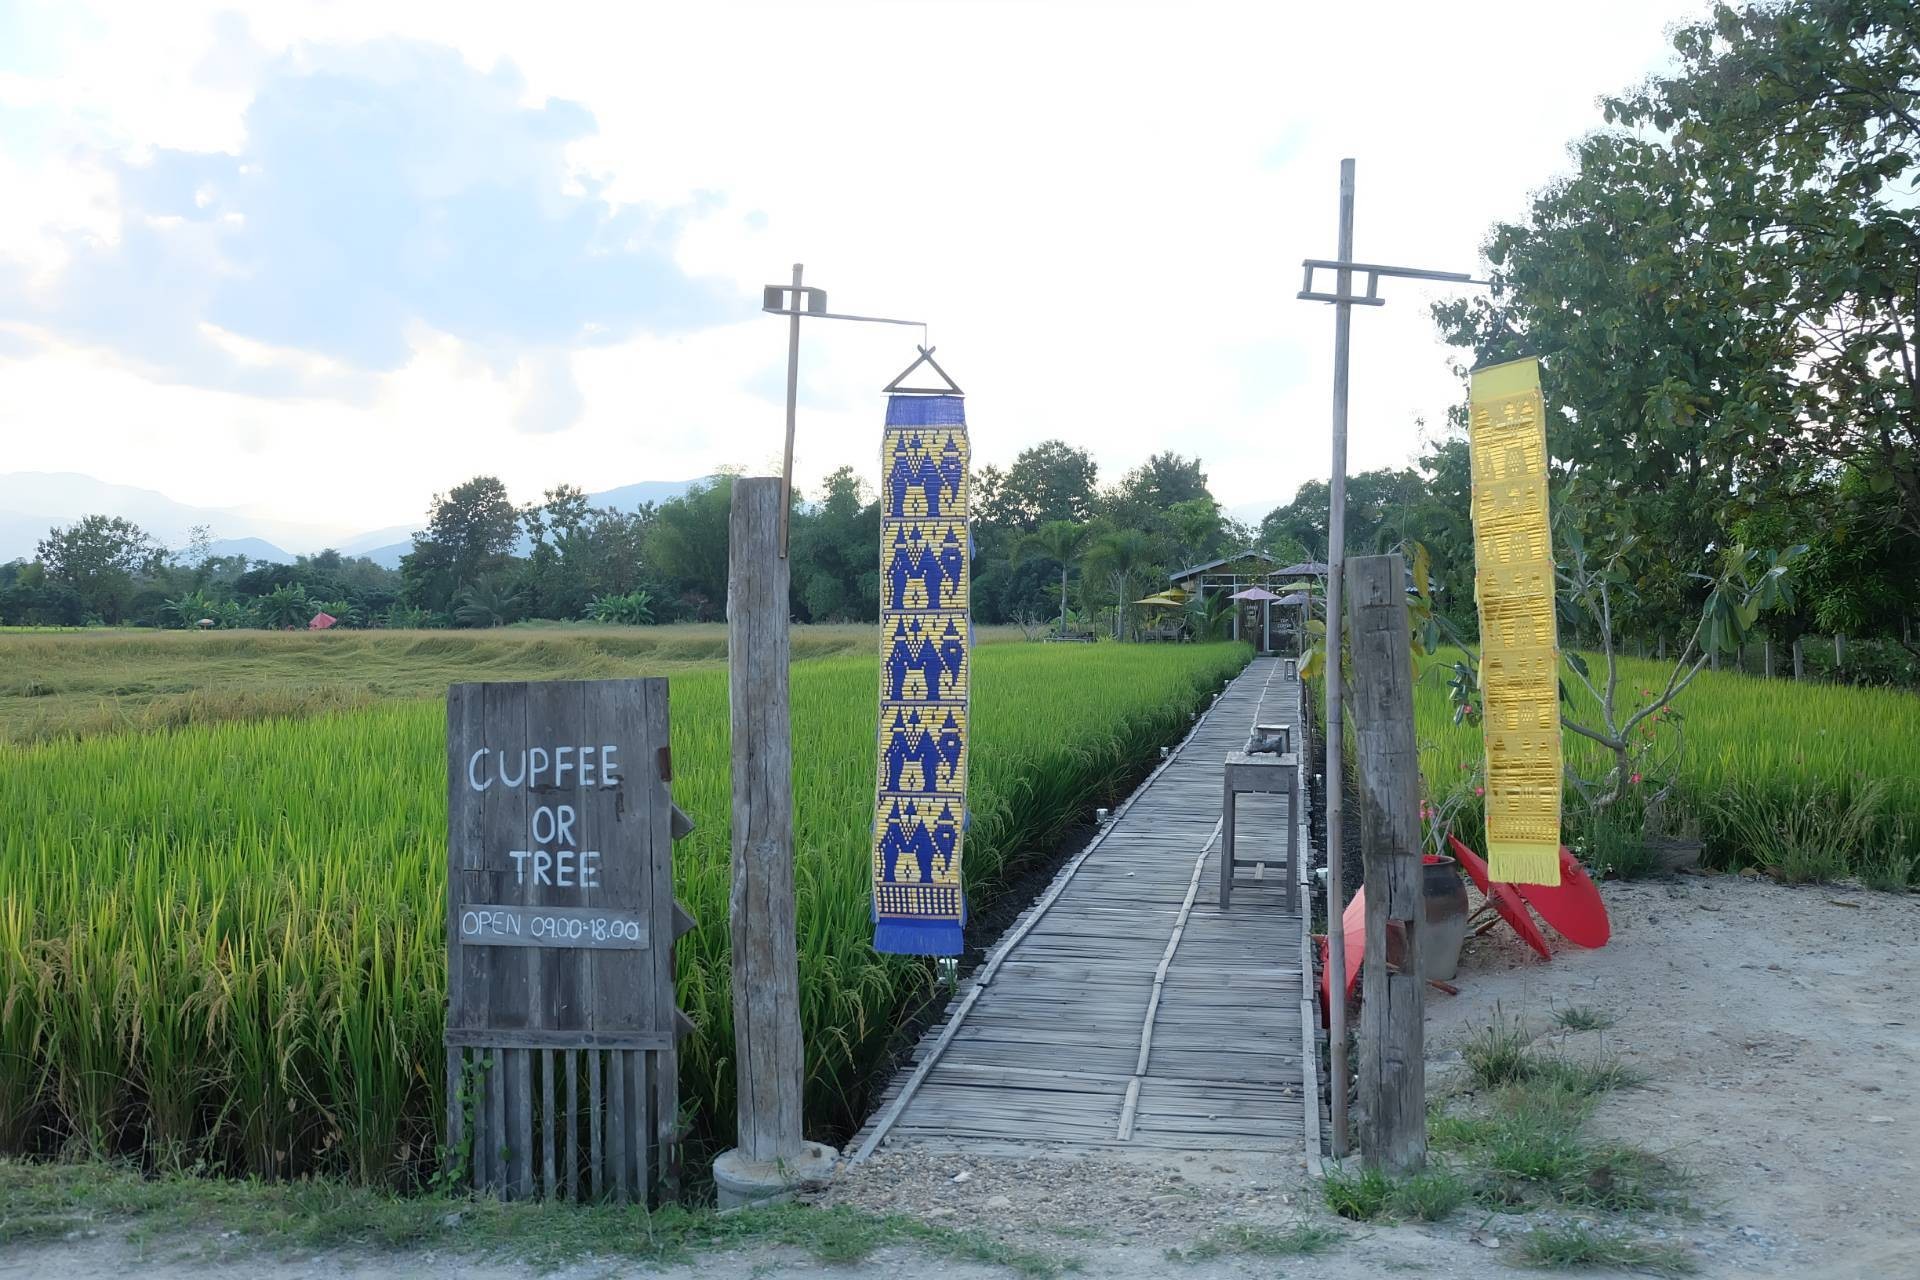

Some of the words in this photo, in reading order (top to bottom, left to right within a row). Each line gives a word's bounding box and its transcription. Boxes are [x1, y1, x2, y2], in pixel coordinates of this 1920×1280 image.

[469, 746, 619, 792] CUPFEE
[532, 805, 577, 847] OR
[509, 851, 600, 888] TREE
[463, 911, 521, 936] OPEN
